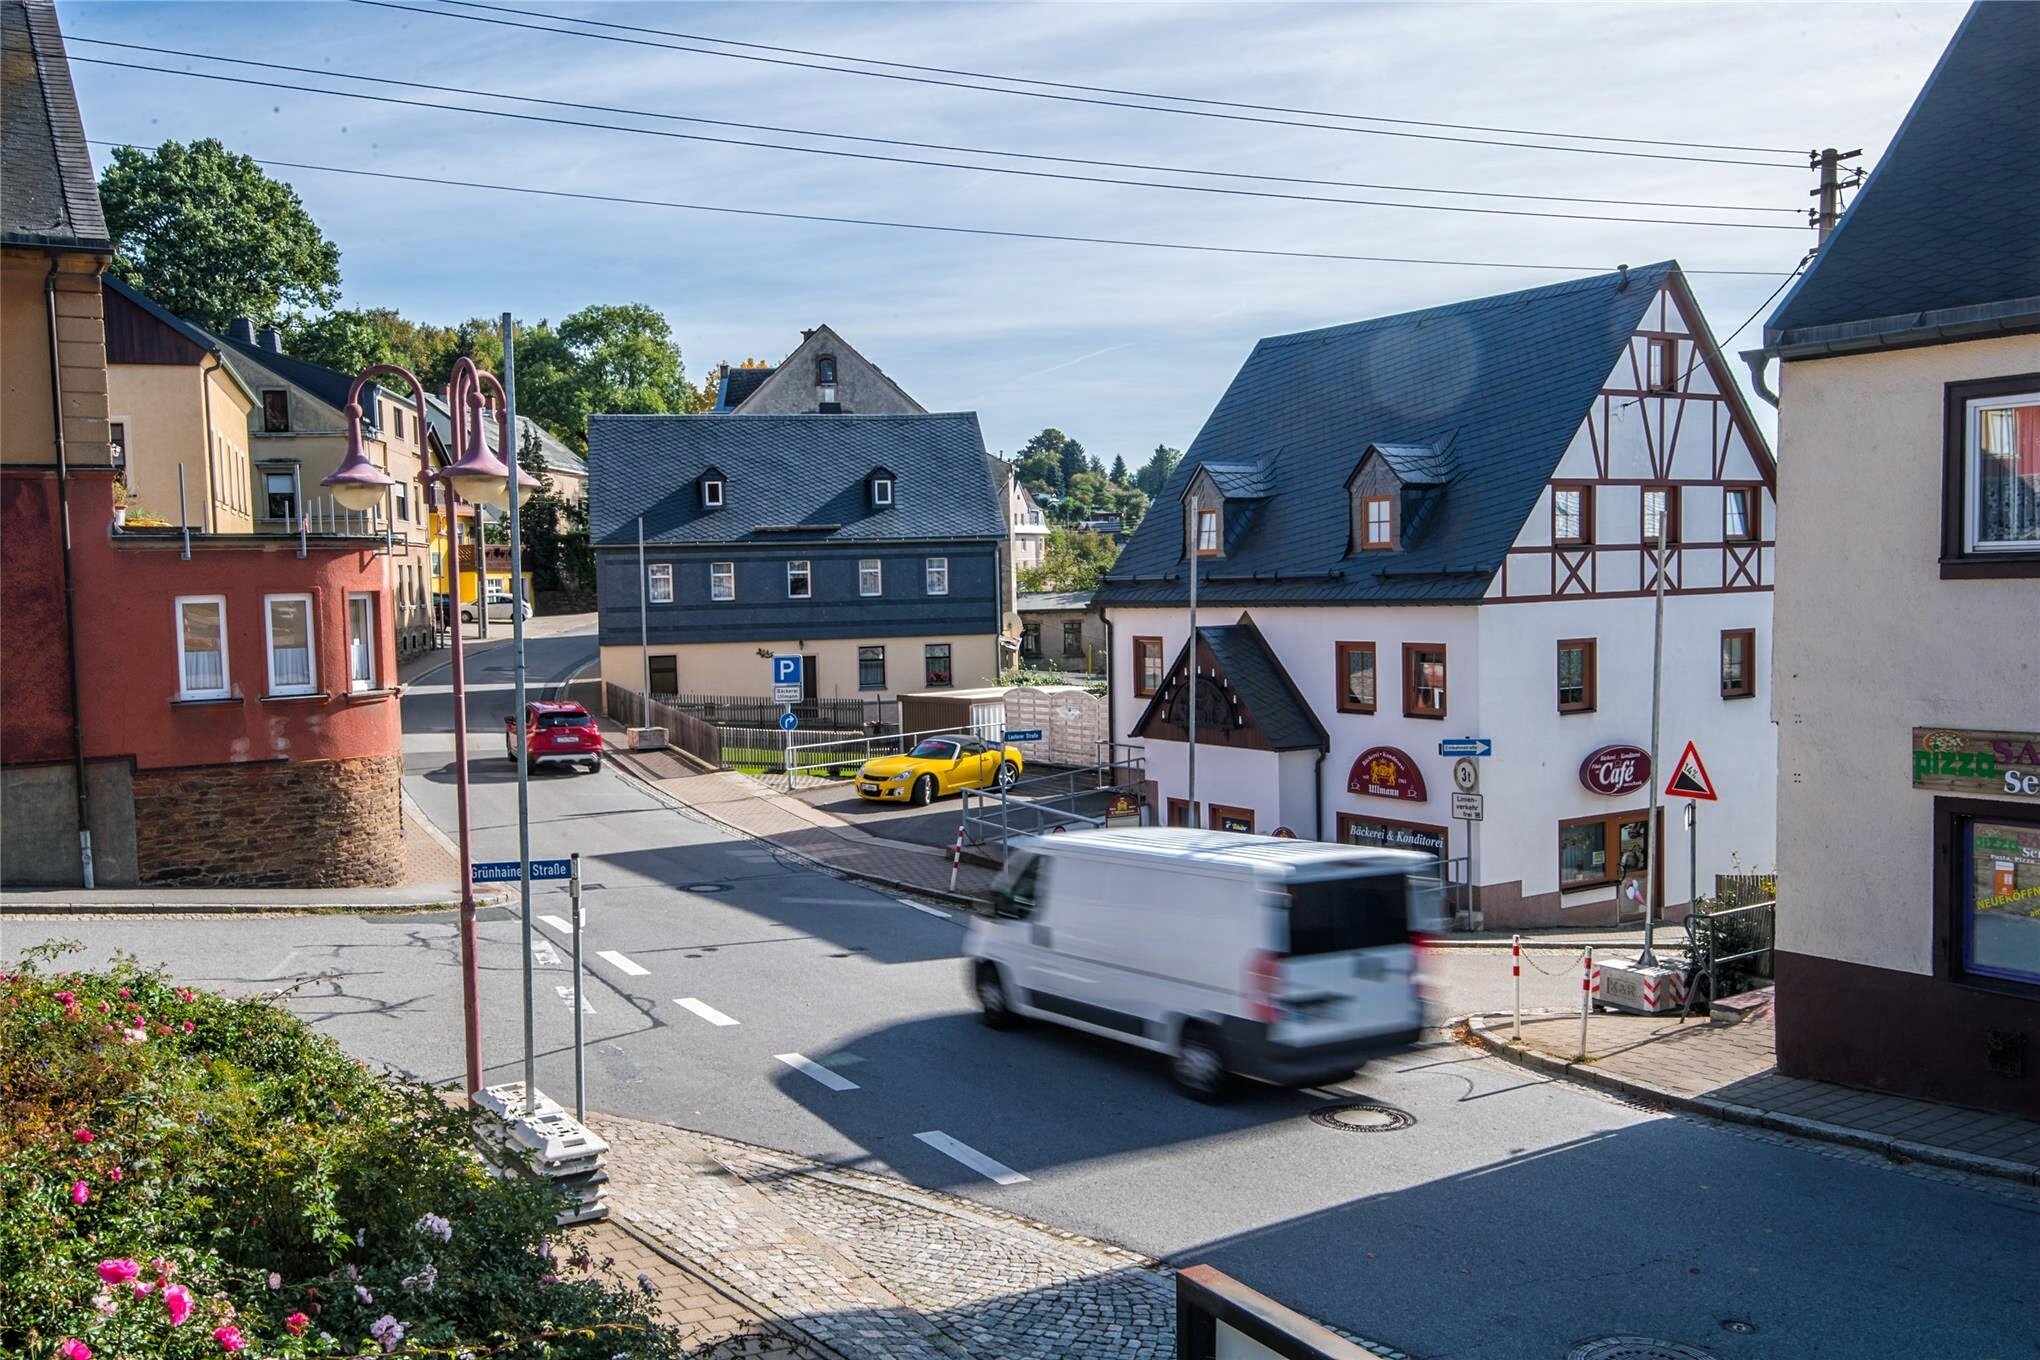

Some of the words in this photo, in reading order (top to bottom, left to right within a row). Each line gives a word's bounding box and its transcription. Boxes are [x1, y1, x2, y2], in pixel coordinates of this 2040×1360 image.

[780, 660, 794, 680] P
[1599, 760, 1635, 789] Café
[1683, 762, 1698, 779] 14%
[1350, 825, 1385, 840] Bäckerei
[1386, 831, 1394, 841] &
[1396, 832, 1444, 848] Konditorei
[472, 866, 523, 878] Grünhaine
[532, 863, 566, 876] Straße
